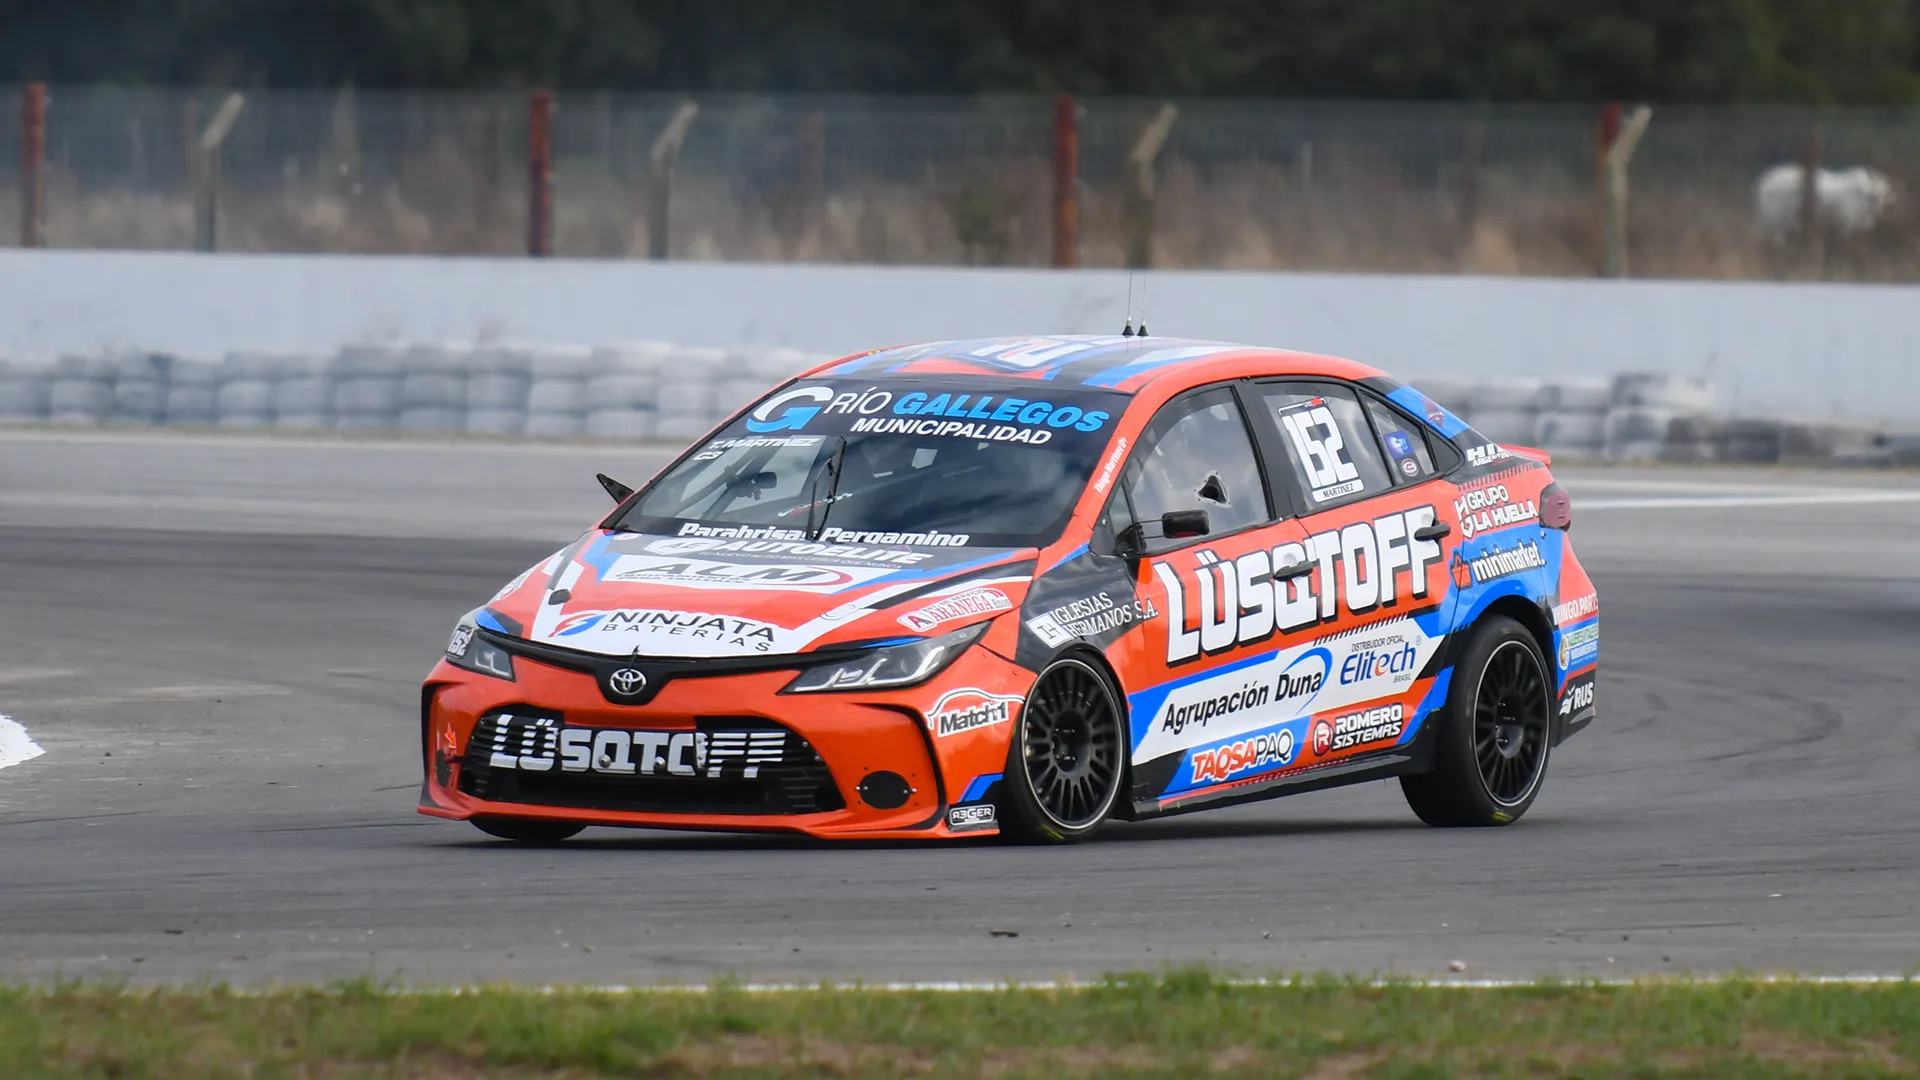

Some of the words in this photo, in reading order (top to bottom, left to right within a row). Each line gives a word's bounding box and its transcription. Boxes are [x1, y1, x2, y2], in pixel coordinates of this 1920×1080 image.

[824, 387, 892, 415] RÍO
[892, 393, 1110, 433] GALLEGOS
[850, 418, 1053, 444] MUNICIPALIDAD
[1281, 407, 1360, 489] 152
[1466, 485, 1509, 512] GRUPO
[1472, 510, 1494, 532] LA
[1491, 500, 1539, 529] HUELLA
[818, 526, 971, 547] Pergamino
[713, 540, 935, 565] AUTOELITE
[624, 562, 823, 582] ALM
[1153, 504, 1443, 668] LÜSQTOFF
[930, 594, 994, 622] ARANEGA
[1049, 592, 1114, 625] IGLESIAS
[1063, 604, 1133, 638] HERMANOS
[1134, 598, 1159, 620] S.A.
[602, 624, 771, 652] BATERIAS
[609, 611, 775, 642] NINJATA
[1351, 637, 1386, 653] DISTRIBUIDOR
[1386, 633, 1405, 647] OFICIAL
[1340, 641, 1417, 685] Elitech
[1162, 680, 1269, 735] Agrupación
[1273, 671, 1323, 703] Duna
[1573, 682, 1595, 710] RUS
[1334, 703, 1403, 735] ROMERO
[1332, 721, 1402, 750] SISTEMAS
